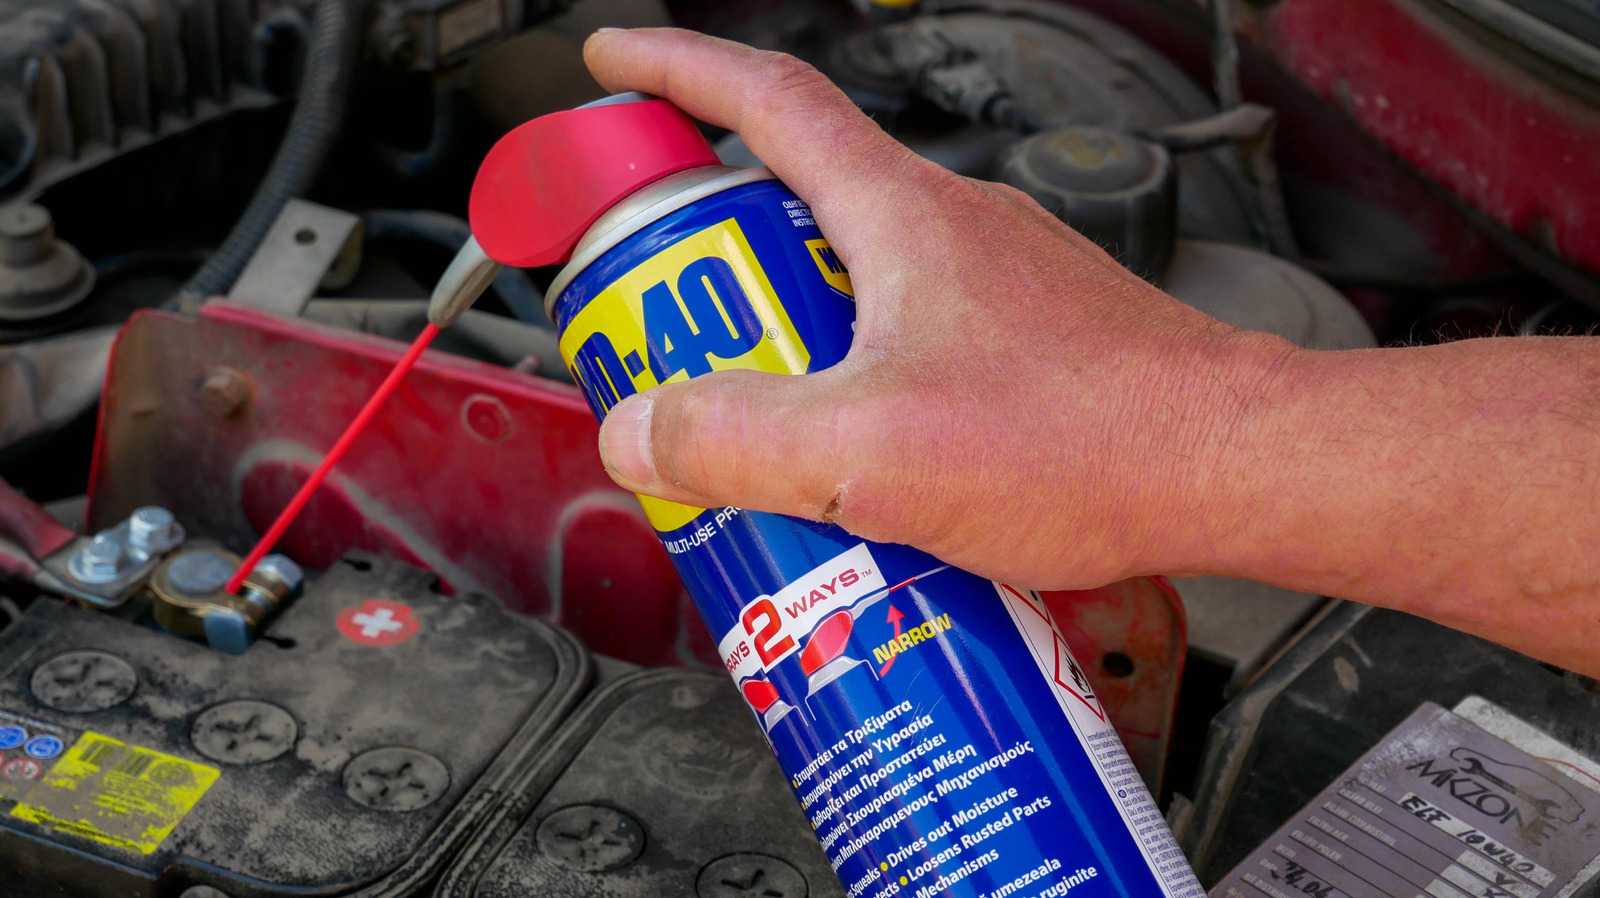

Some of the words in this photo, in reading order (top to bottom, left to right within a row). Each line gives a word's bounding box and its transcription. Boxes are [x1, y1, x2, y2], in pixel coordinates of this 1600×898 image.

[664, 526, 717, 556] MULTI-USE
[714, 504, 743, 529] PR
[742, 599, 797, 668] 2
[784, 567, 860, 619] WAYS
[872, 613, 952, 665] NARROW
[831, 739, 849, 755] τα
[845, 700, 913, 744] Τριξίματα
[850, 748, 874, 769] την
[871, 713, 934, 754] Υγρασία
[843, 784, 863, 802] και
[859, 733, 947, 789] Προστατεύει
[845, 766, 934, 827] Σκουριασμένα
[932, 742, 978, 773] Μέρη
[934, 739, 1034, 799] Μηχανισμούς
[850, 866, 881, 896] Squeaks
[886, 836, 928, 868] Drives
[927, 820, 954, 842] out
[951, 786, 1019, 827] Moisture
[906, 843, 962, 882] Loosens
[960, 815, 1014, 850] Rusted
[1013, 794, 1052, 823] Parts
[915, 848, 1000, 898] Mechanisms
[990, 858, 1062, 898] umezeala
[1039, 866, 1098, 898] ruginite
